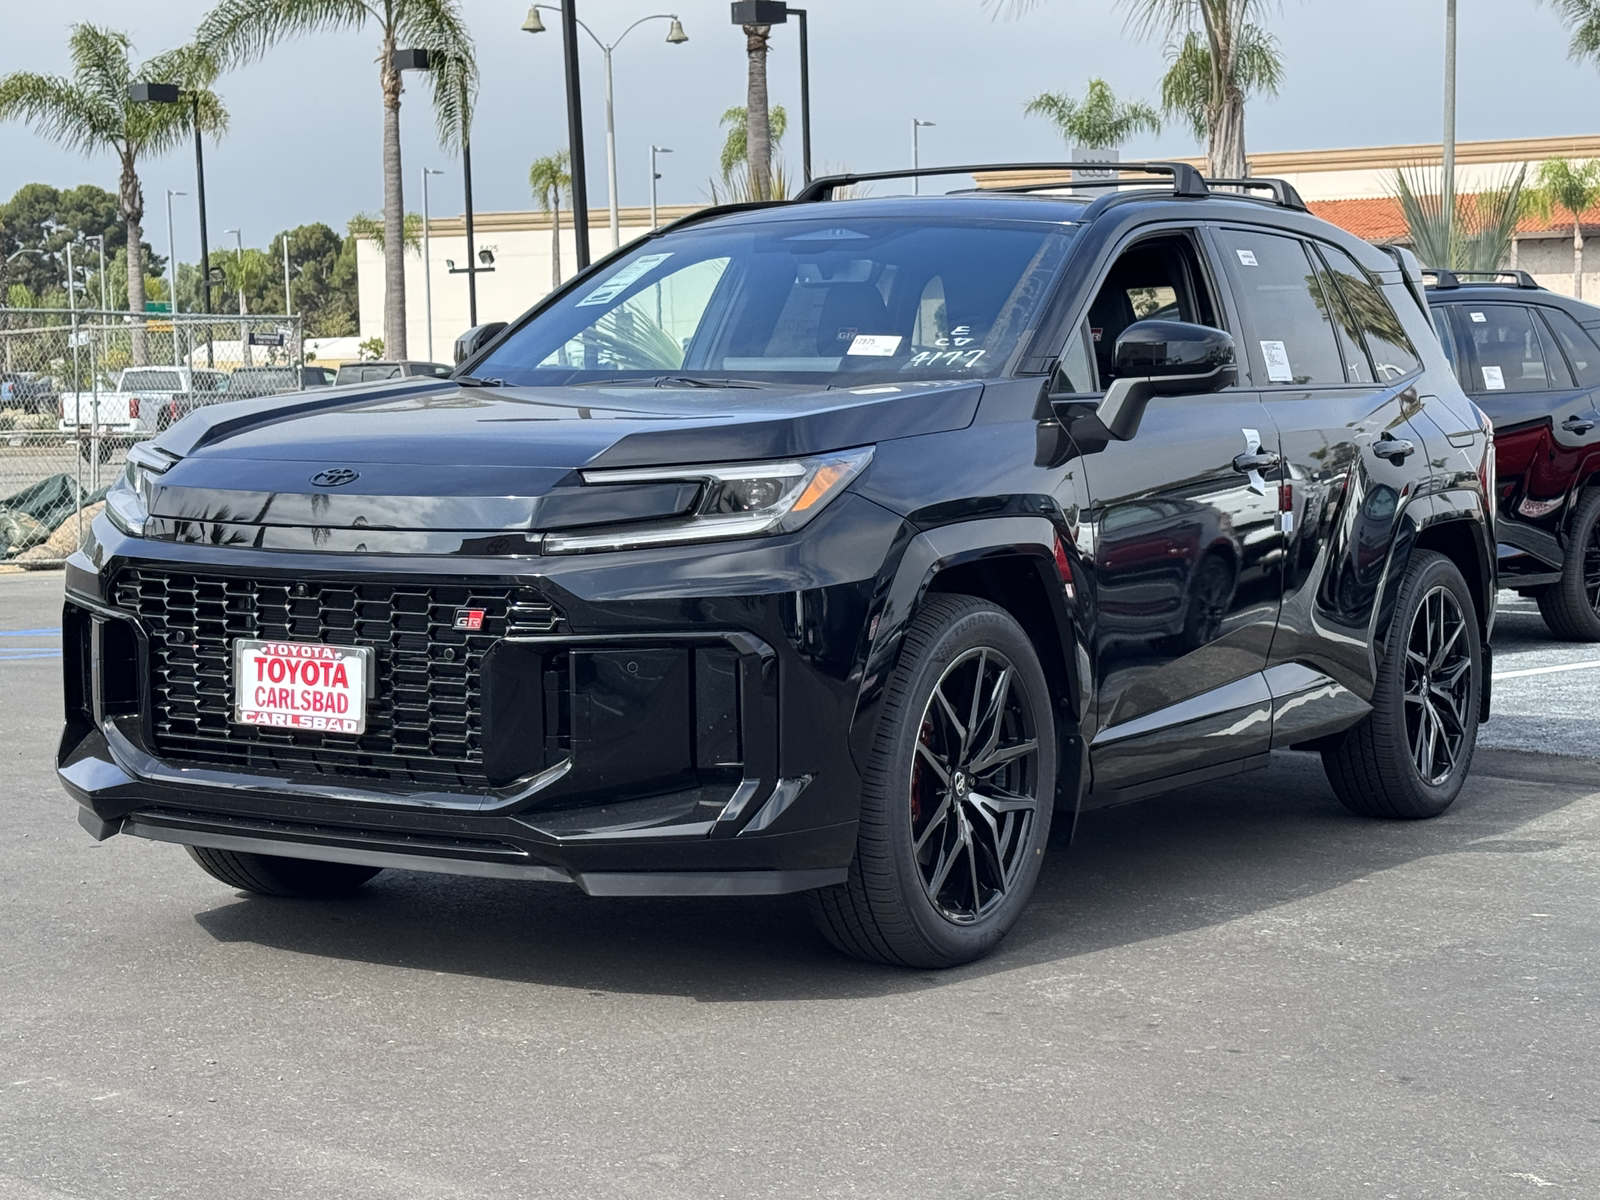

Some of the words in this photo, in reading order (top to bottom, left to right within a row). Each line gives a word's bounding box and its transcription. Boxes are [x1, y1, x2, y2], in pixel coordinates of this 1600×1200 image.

[950, 325, 970, 336] E
[910, 349, 986, 368] 4177
[456, 617, 481, 627] GR
[267, 643, 333, 660] TOYOTA
[254, 656, 349, 689] TOYOTA
[254, 685, 349, 714] CARLSBAD
[241, 711, 357, 732] CARLSBAD
